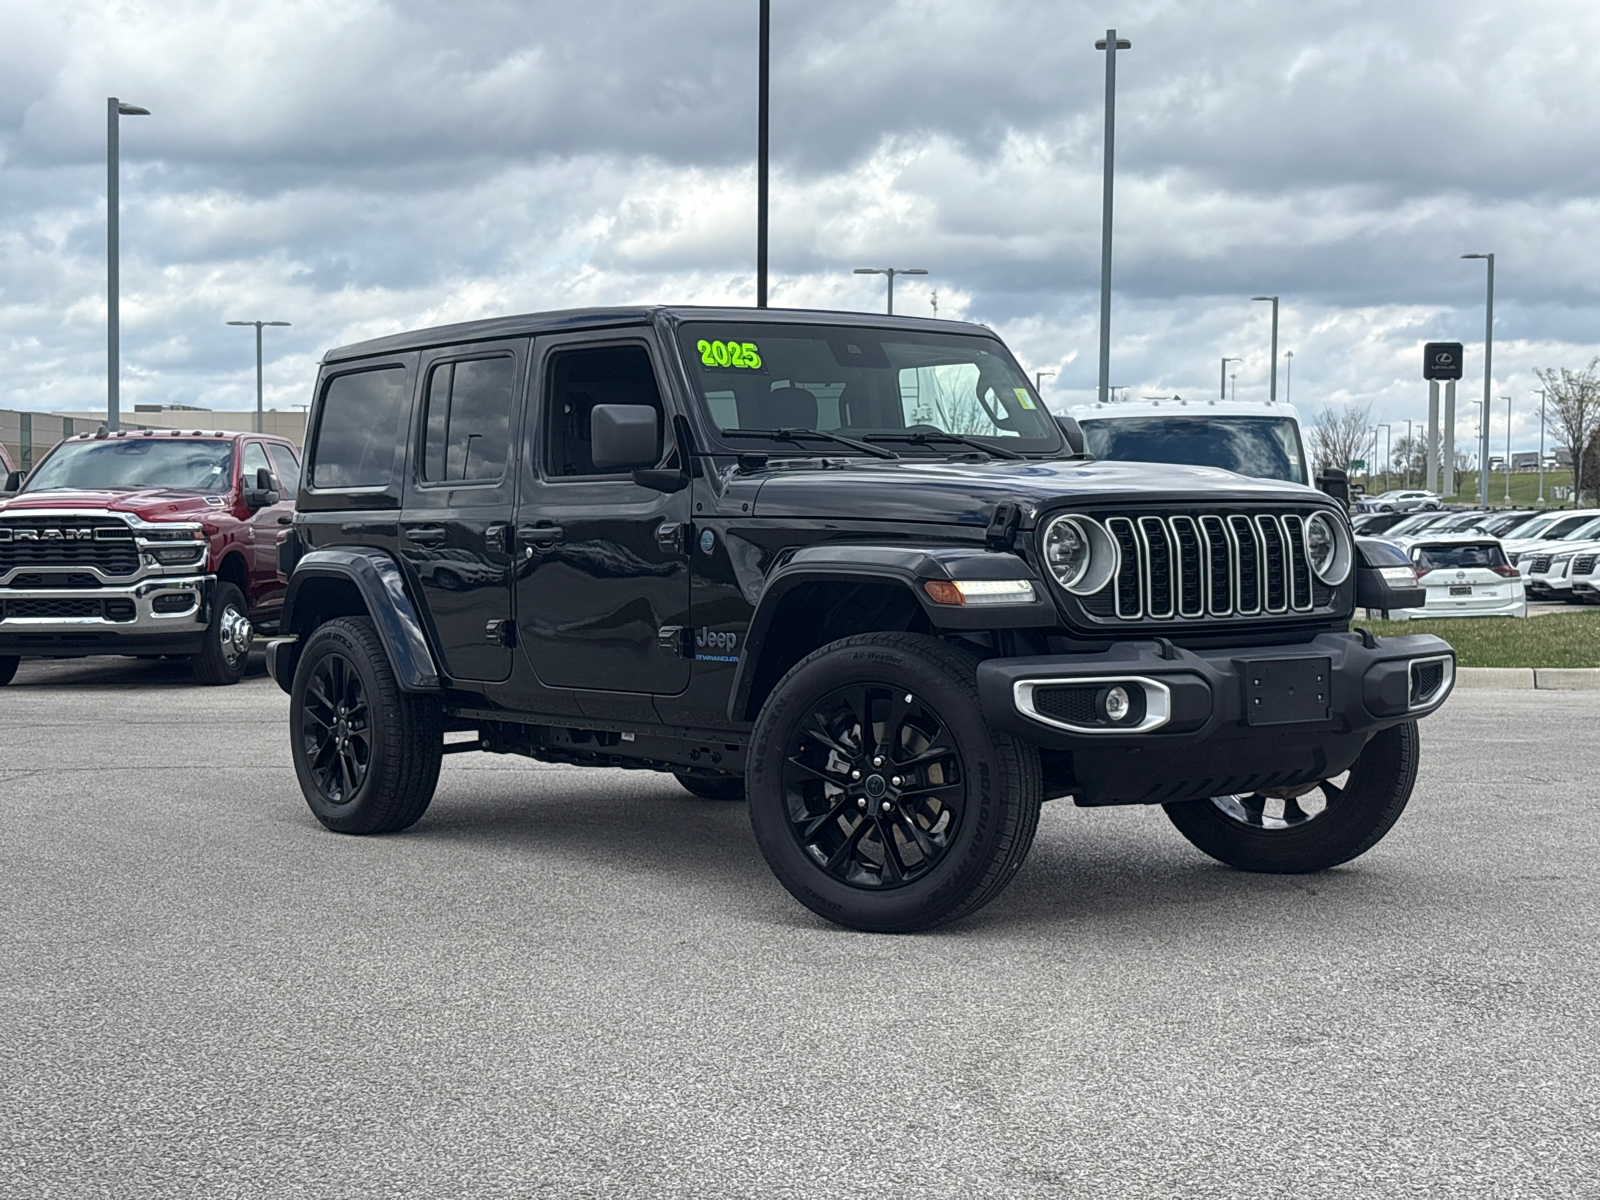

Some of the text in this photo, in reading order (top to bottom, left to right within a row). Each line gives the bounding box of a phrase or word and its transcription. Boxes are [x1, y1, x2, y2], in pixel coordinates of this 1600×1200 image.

[697, 339, 762, 369] 2025
[13, 528, 93, 540] RAM
[696, 626, 737, 653] Jeep
[852, 652, 904, 664] All-Weather
[755, 697, 788, 774] NEXEN
